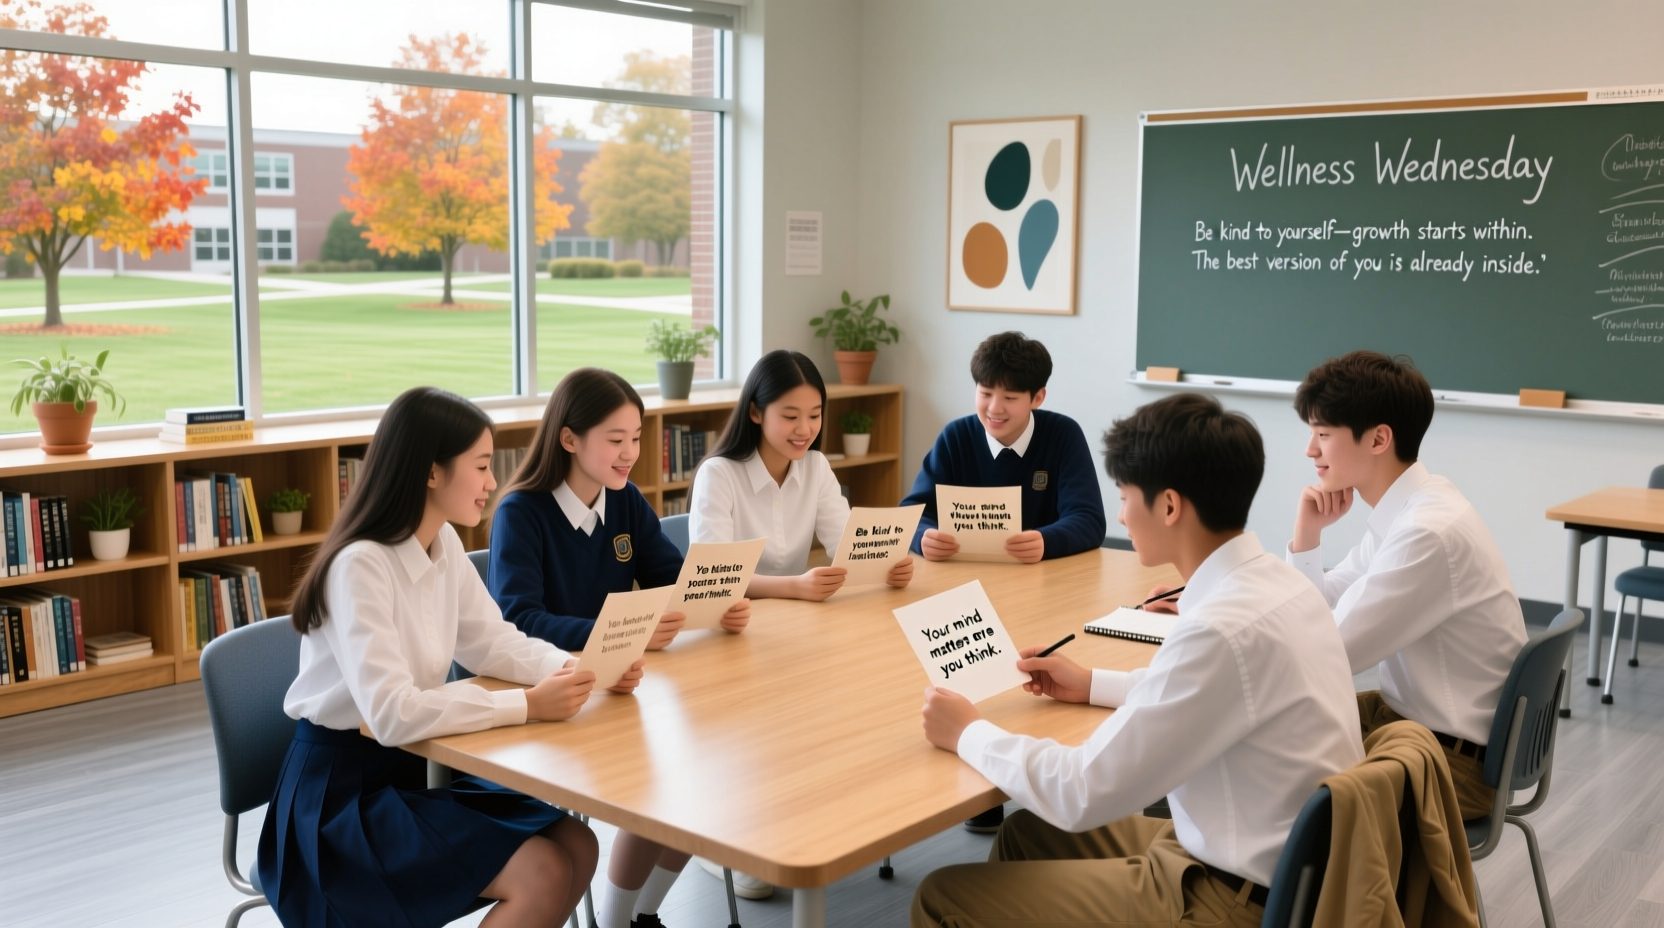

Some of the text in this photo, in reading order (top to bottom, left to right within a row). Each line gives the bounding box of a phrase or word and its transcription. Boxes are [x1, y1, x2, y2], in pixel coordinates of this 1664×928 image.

[1230, 133, 1553, 205] Wellness Wednesday
[1195, 220, 1213, 242] Be
[1220, 220, 1251, 241] kind
[1255, 221, 1272, 240] to
[1417, 220, 1467, 240] starts
[1473, 217, 1533, 240] within.
[1192, 249, 1220, 270] The
[1227, 249, 1259, 270] best
[1266, 252, 1321, 271] version
[1330, 250, 1349, 271] of
[1354, 257, 1382, 280] you
[1390, 253, 1402, 271] is
[1410, 249, 1474, 282] already
[921, 607, 983, 642] Your mind
[940, 642, 1002, 679] you think.
